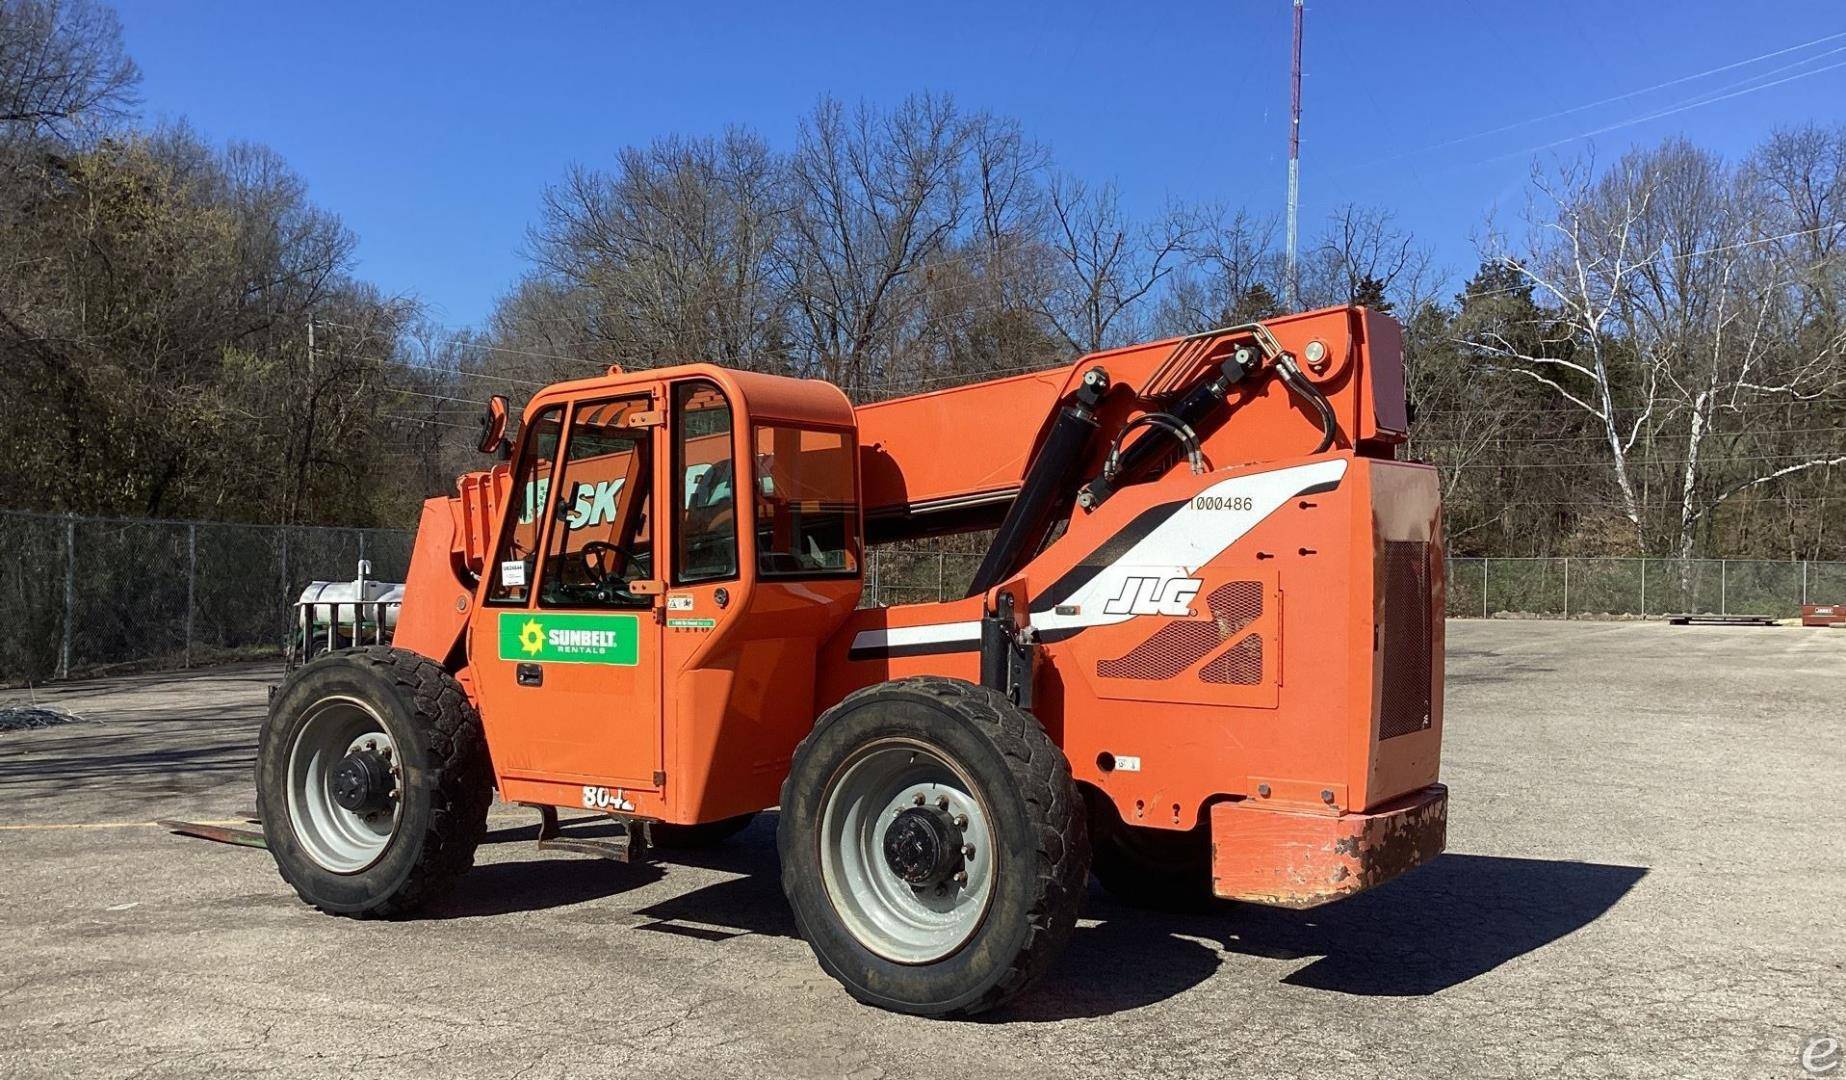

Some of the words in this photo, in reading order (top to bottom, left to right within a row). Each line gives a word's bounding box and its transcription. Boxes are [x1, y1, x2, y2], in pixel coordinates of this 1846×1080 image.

[1190, 496, 1253, 511] 1000486
[1103, 576, 1205, 617] JLG
[548, 629, 617, 648] SUNBELT
[557, 645, 606, 654] RENTALS
